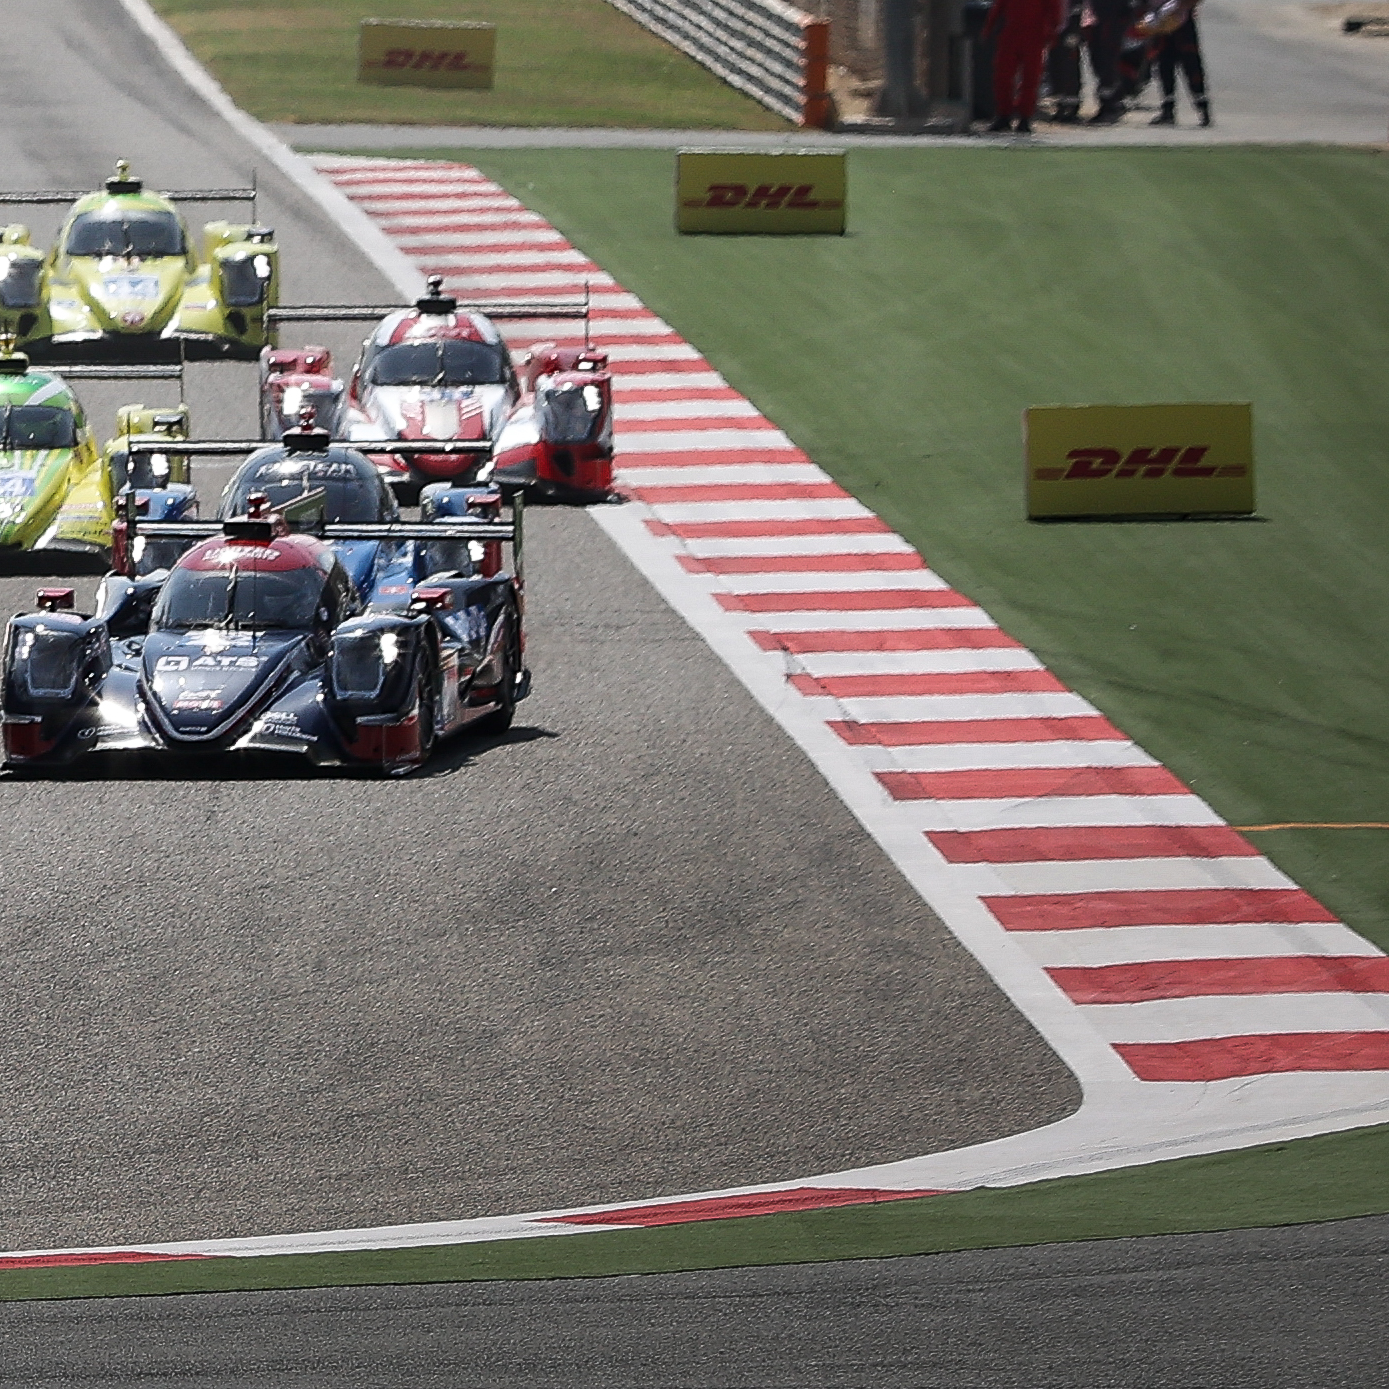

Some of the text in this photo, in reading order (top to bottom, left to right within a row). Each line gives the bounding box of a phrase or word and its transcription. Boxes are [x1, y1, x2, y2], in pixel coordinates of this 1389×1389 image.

[382, 48, 470, 70] DHL
[705, 184, 819, 207] DHL
[1063, 446, 1219, 479] DHL
